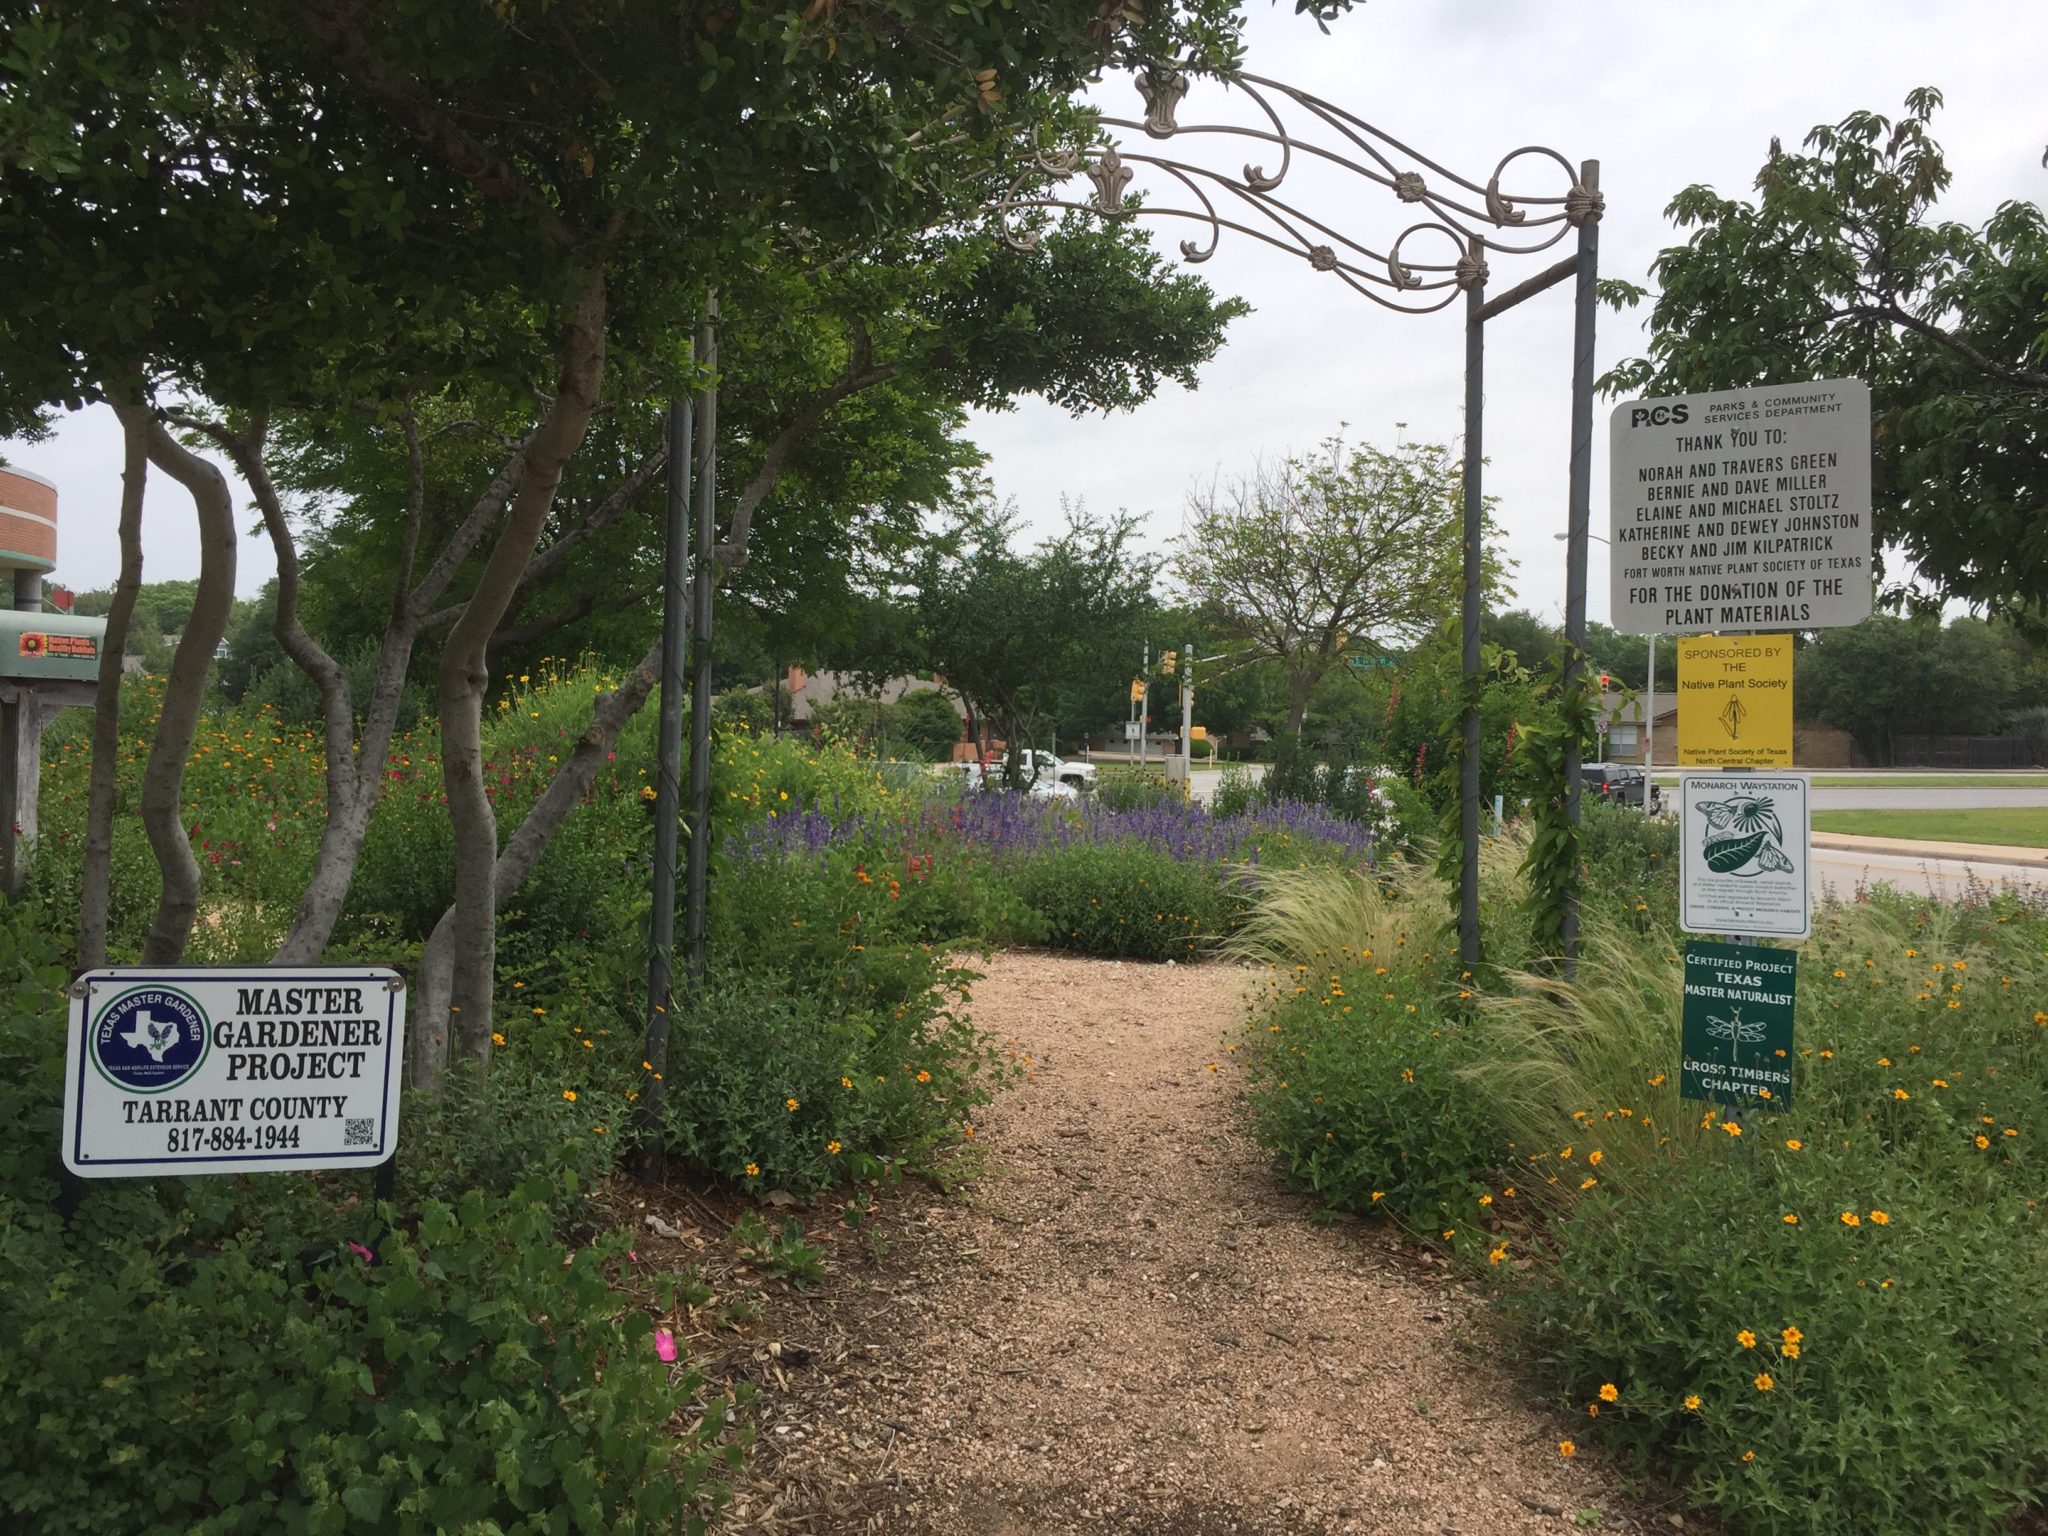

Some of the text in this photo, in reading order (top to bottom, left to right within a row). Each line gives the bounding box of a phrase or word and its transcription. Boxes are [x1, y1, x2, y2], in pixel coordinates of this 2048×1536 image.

[1704, 404, 1841, 424] SERVICES DEPARTMENT
[1710, 394, 1835, 412] PARKS & COMMUNITY
[1676, 428, 1787, 452] THANK YOU TO:
[1639, 453, 1837, 482] NORAH AND TRAVERS GREEN
[1648, 474, 1826, 501] BERNIE AND DAVE MILLER
[1637, 494, 1838, 521] ELAINE AND MICHAEL STOLTZ
[1619, 514, 1859, 542] KATHERINE AND DEWEY JOHNSTON
[1642, 536, 1833, 560] BECKY AND JIM KILPATRICK
[1625, 557, 1861, 579] FORT WORTH NATIVE PLANT SOCIETY OF TEXAS
[1630, 579, 1842, 604] FOR THE DONATION OF THE
[1666, 604, 1810, 625] PLANT MATERIALS
[1685, 648, 1781, 659] SPONSORED BY
[1723, 663, 1746, 672] THE
[1682, 679, 1787, 689] Native Plant Society
[1745, 758, 1774, 766] Chapter
[1740, 782, 1798, 790] WAYSTATION
[1687, 954, 1793, 974] CERTIFIED PROJECT
[1716, 972, 1762, 986] TEXAS
[236, 988, 363, 1015] MASTER
[1685, 984, 1792, 1005] MASTER NATURALIST
[101, 994, 200, 1044] TEXAS MASTER GARDENER
[214, 1020, 382, 1048] GARDENER
[226, 1052, 365, 1081] PROJECT
[1683, 1061, 1790, 1083] CROSS TIMBERS
[123, 1096, 347, 1123] TARRANT COUNTY
[168, 1125, 299, 1152] 817-884-1944
